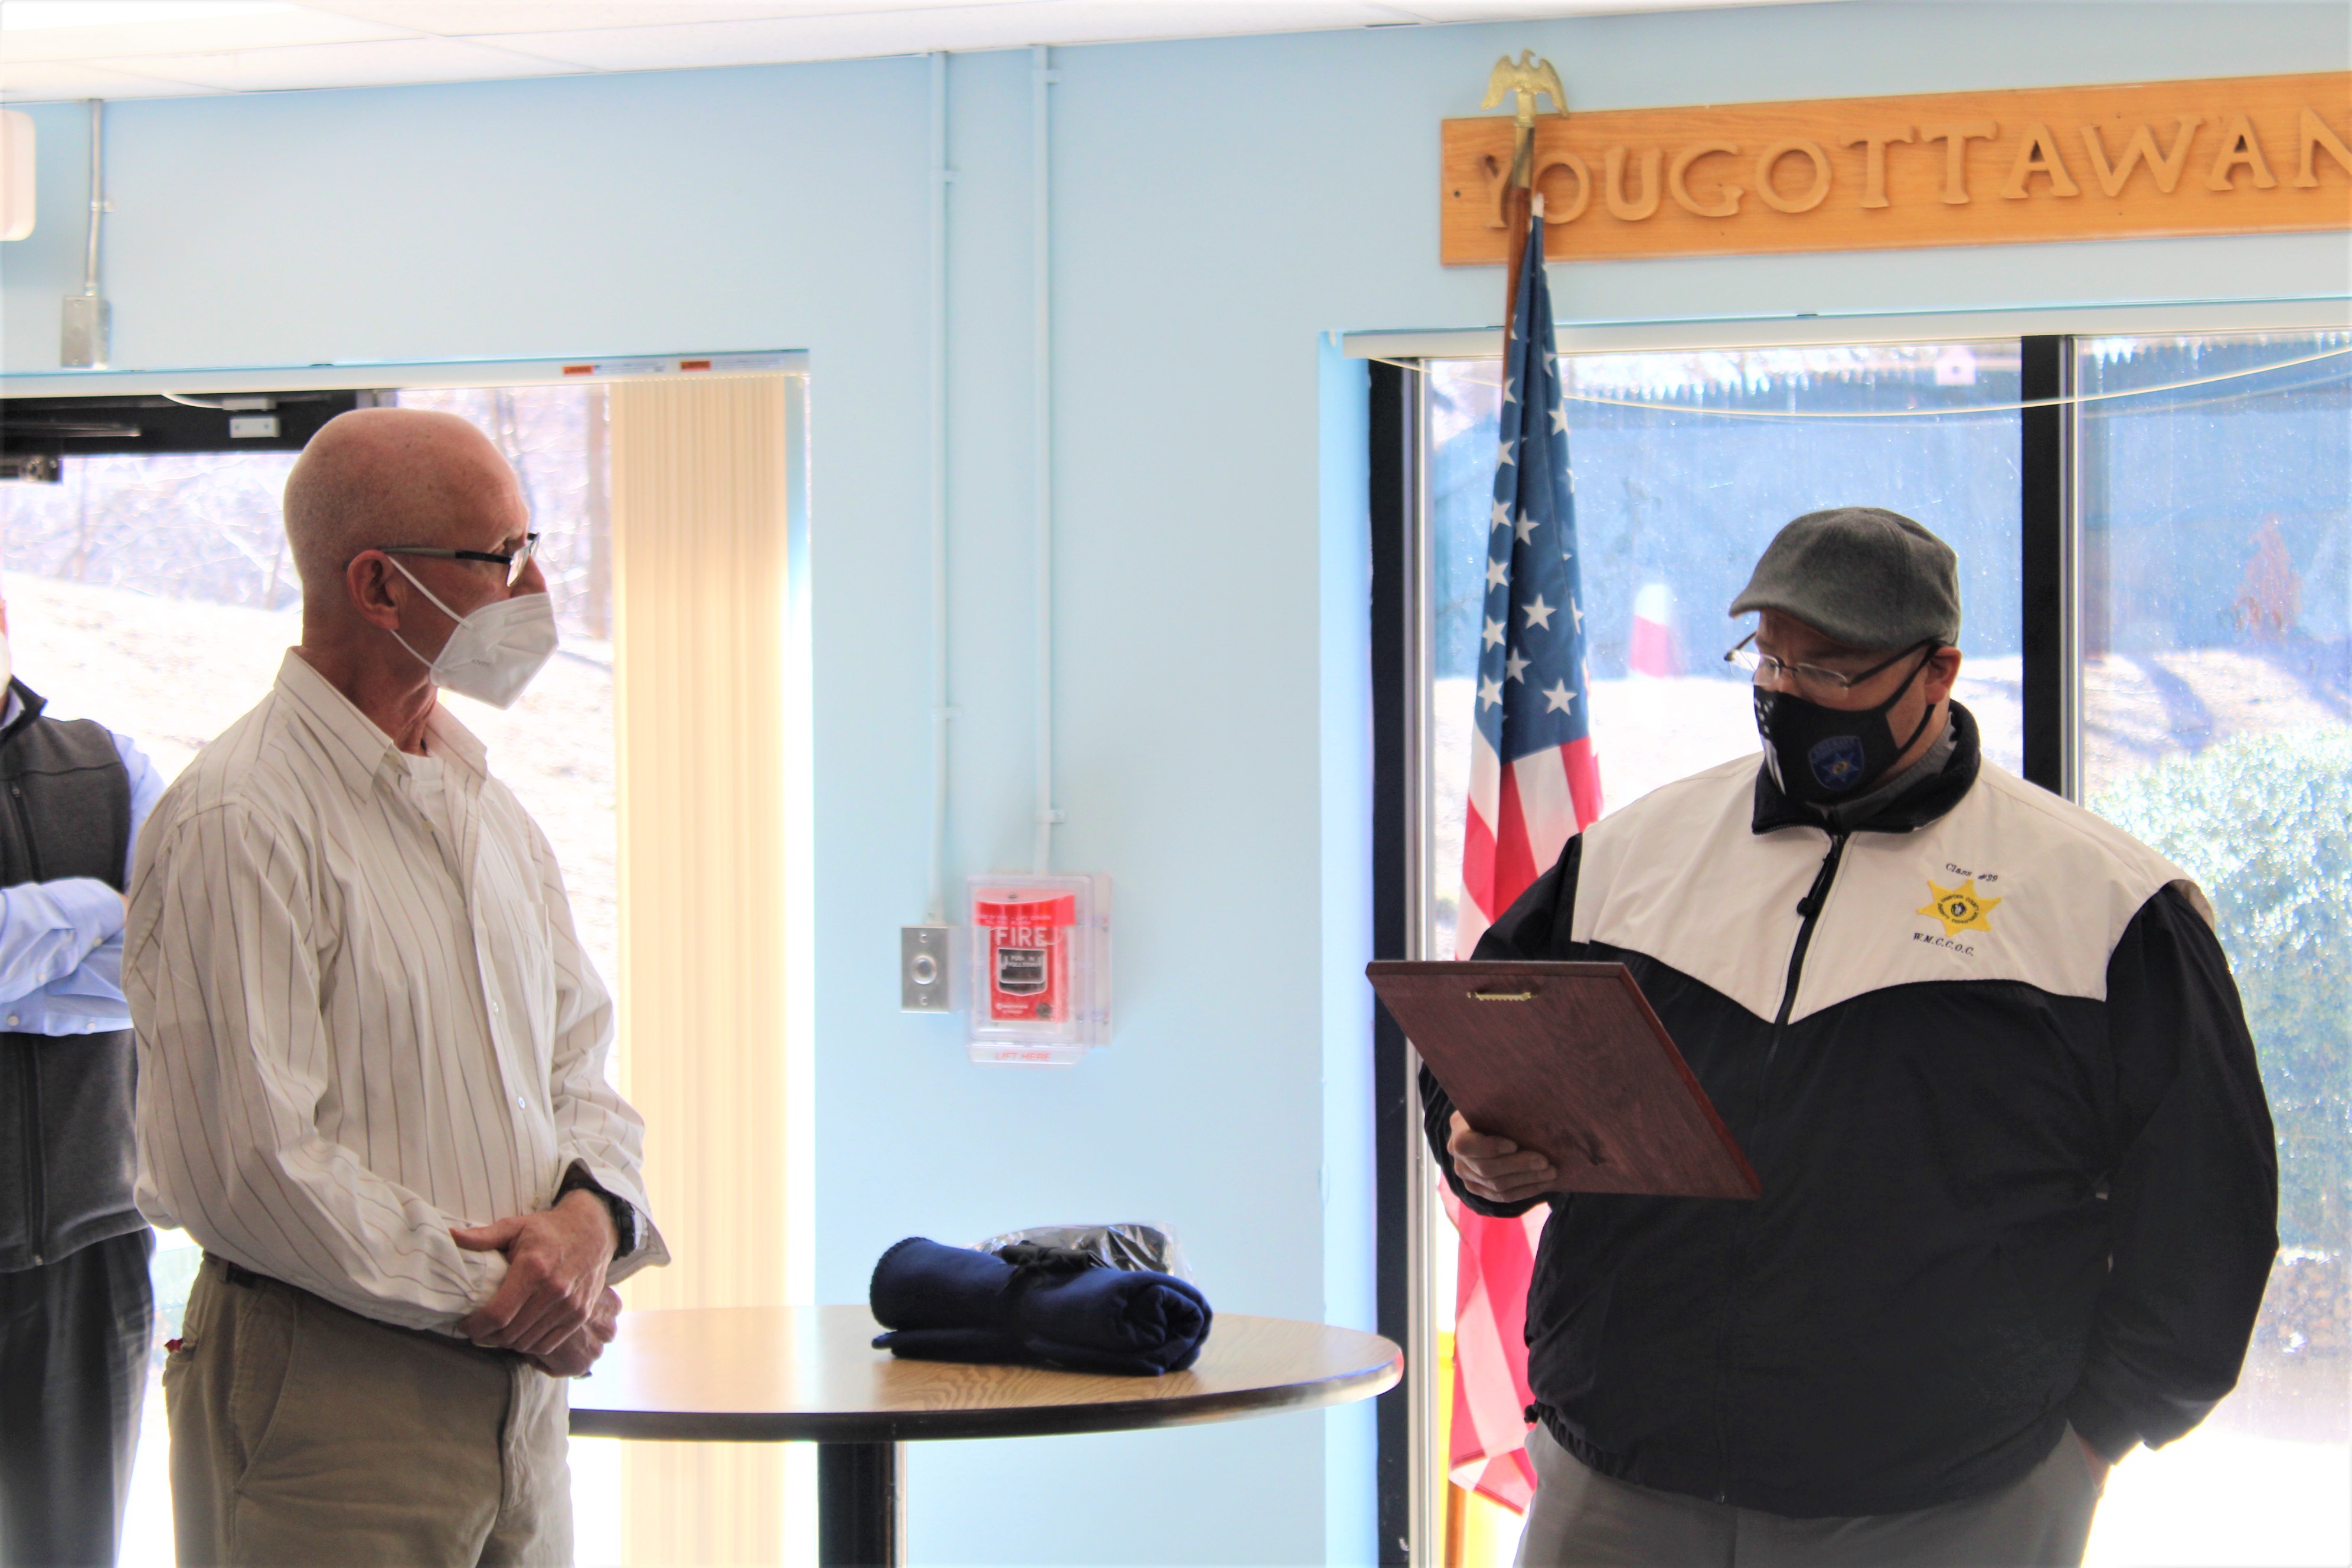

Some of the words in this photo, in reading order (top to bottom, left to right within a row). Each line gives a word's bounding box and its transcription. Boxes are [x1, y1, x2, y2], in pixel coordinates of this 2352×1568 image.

[1945, 863, 1972, 877] Class
[1978, 874, 1998, 883] #39
[995, 926, 1048, 948] FIRE
[1913, 932, 1974, 956] W.M.C.C.O.C.
[995, 1052, 1017, 1060] LIFT
[1021, 1053, 1051, 1061] HERE
